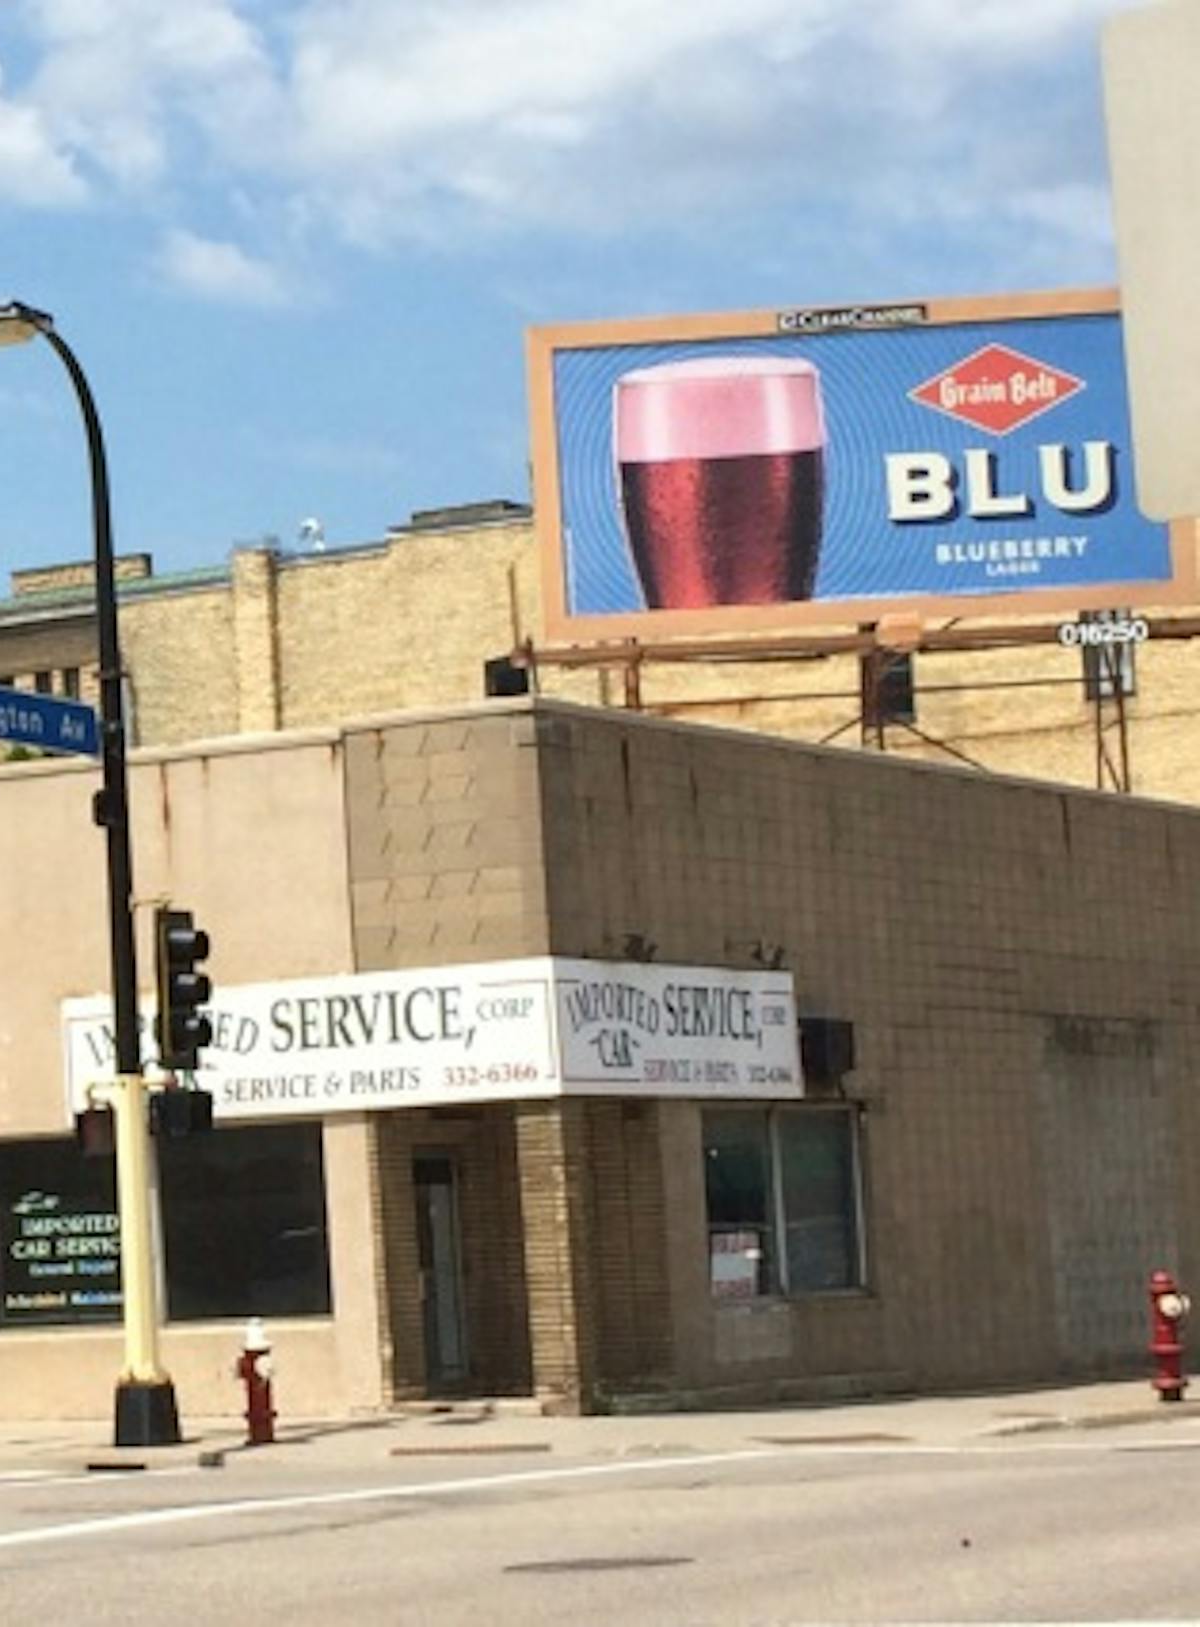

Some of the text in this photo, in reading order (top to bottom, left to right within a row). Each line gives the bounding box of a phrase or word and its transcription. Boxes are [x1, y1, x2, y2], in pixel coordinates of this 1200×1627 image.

[939, 371, 1057, 408] Grain Belt
[883, 440, 1117, 524] BLU
[936, 536, 1088, 564] BLUEBERRY
[1060, 619, 1148, 645] 016250
[270, 986, 476, 1050] SERVICE,
[476, 997, 535, 1022] CORP
[566, 982, 660, 1034] IMPORTED
[663, 984, 763, 1050] SERVICE,
[222, 1074, 316, 1103] SERVICE
[323, 1072, 342, 1097] &
[349, 1067, 421, 1094] PARTS
[444, 1063, 537, 1087] 332-6366
[20, 1213, 120, 1237] IMPORTED
[9, 1236, 122, 1260] CAR SERVIC
